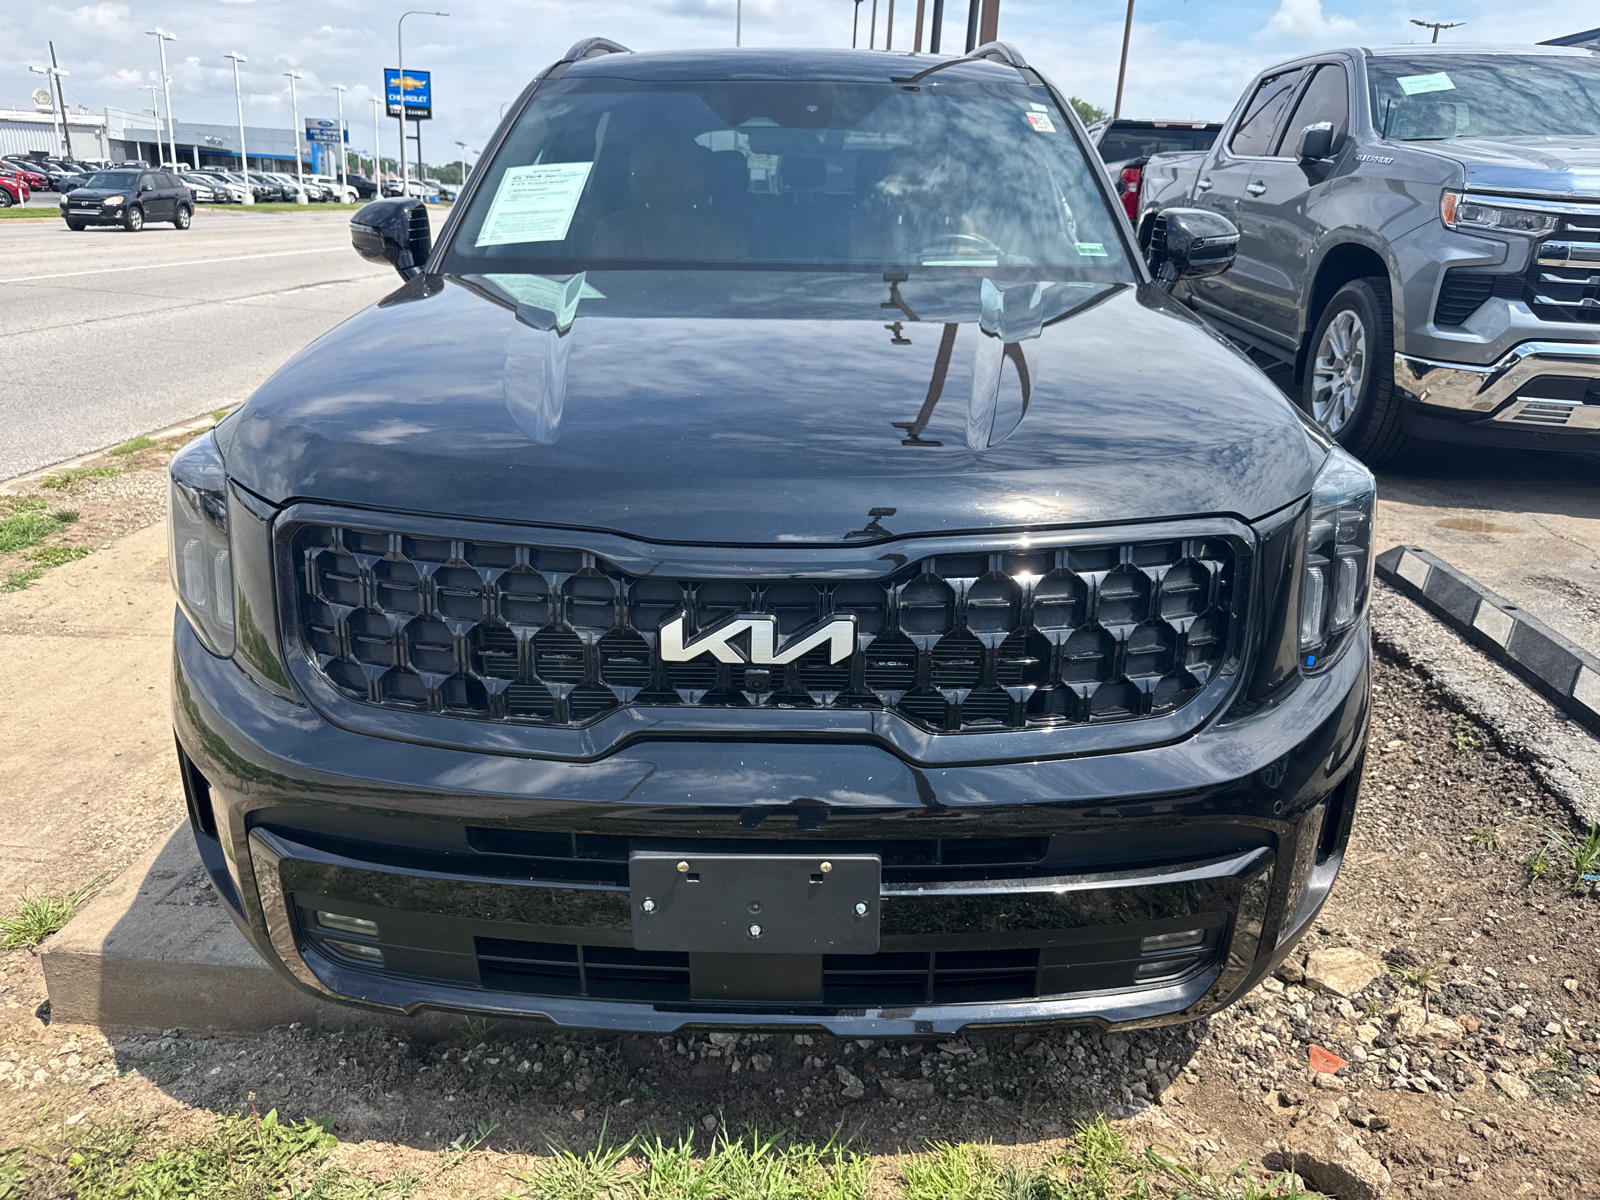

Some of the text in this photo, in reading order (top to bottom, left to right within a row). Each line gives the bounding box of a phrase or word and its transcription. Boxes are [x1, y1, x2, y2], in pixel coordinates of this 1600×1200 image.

[388, 93, 428, 103] CHEVROLET
[310, 128, 341, 136] PRE-OWNE
[659, 613, 857, 666] KIA
